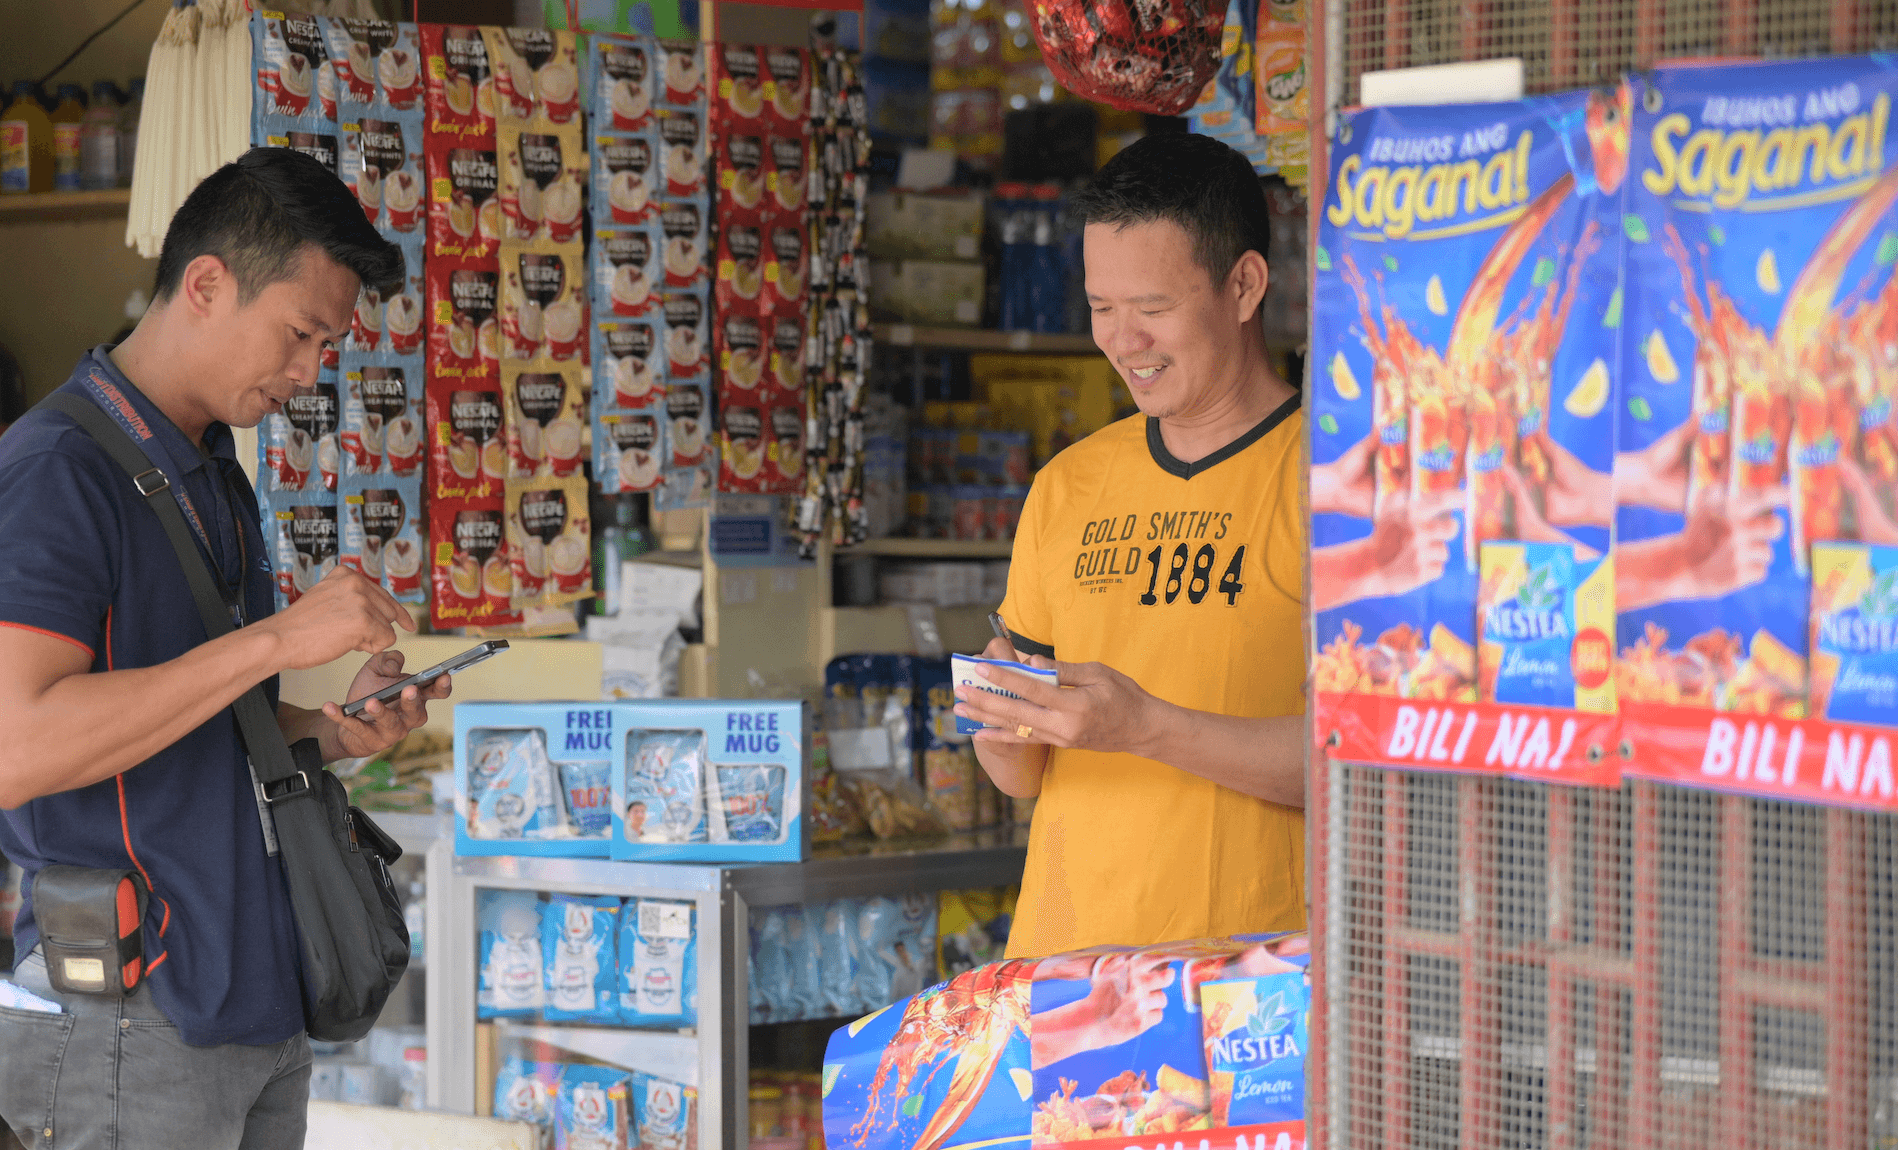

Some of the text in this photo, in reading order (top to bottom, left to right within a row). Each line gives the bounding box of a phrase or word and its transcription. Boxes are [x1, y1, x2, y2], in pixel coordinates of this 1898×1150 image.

[1369, 122, 1508, 163] IBUHOS ANG
[1642, 92, 1892, 208] Sagana!
[1328, 130, 1533, 238] Sagana!
[1081, 511, 1232, 546] GOLD SMITH'S
[1074, 542, 1248, 608] GUILD 1884
[1484, 606, 1569, 639] NESTEA
[726, 712, 779, 732] FREE
[1388, 706, 1578, 770] BILI NA!
[725, 734, 780, 753] MUG
[1701, 717, 1895, 797] BILI NA
[1212, 1034, 1301, 1065] NESTEA
[1234, 1074, 1294, 1101] Lemon
